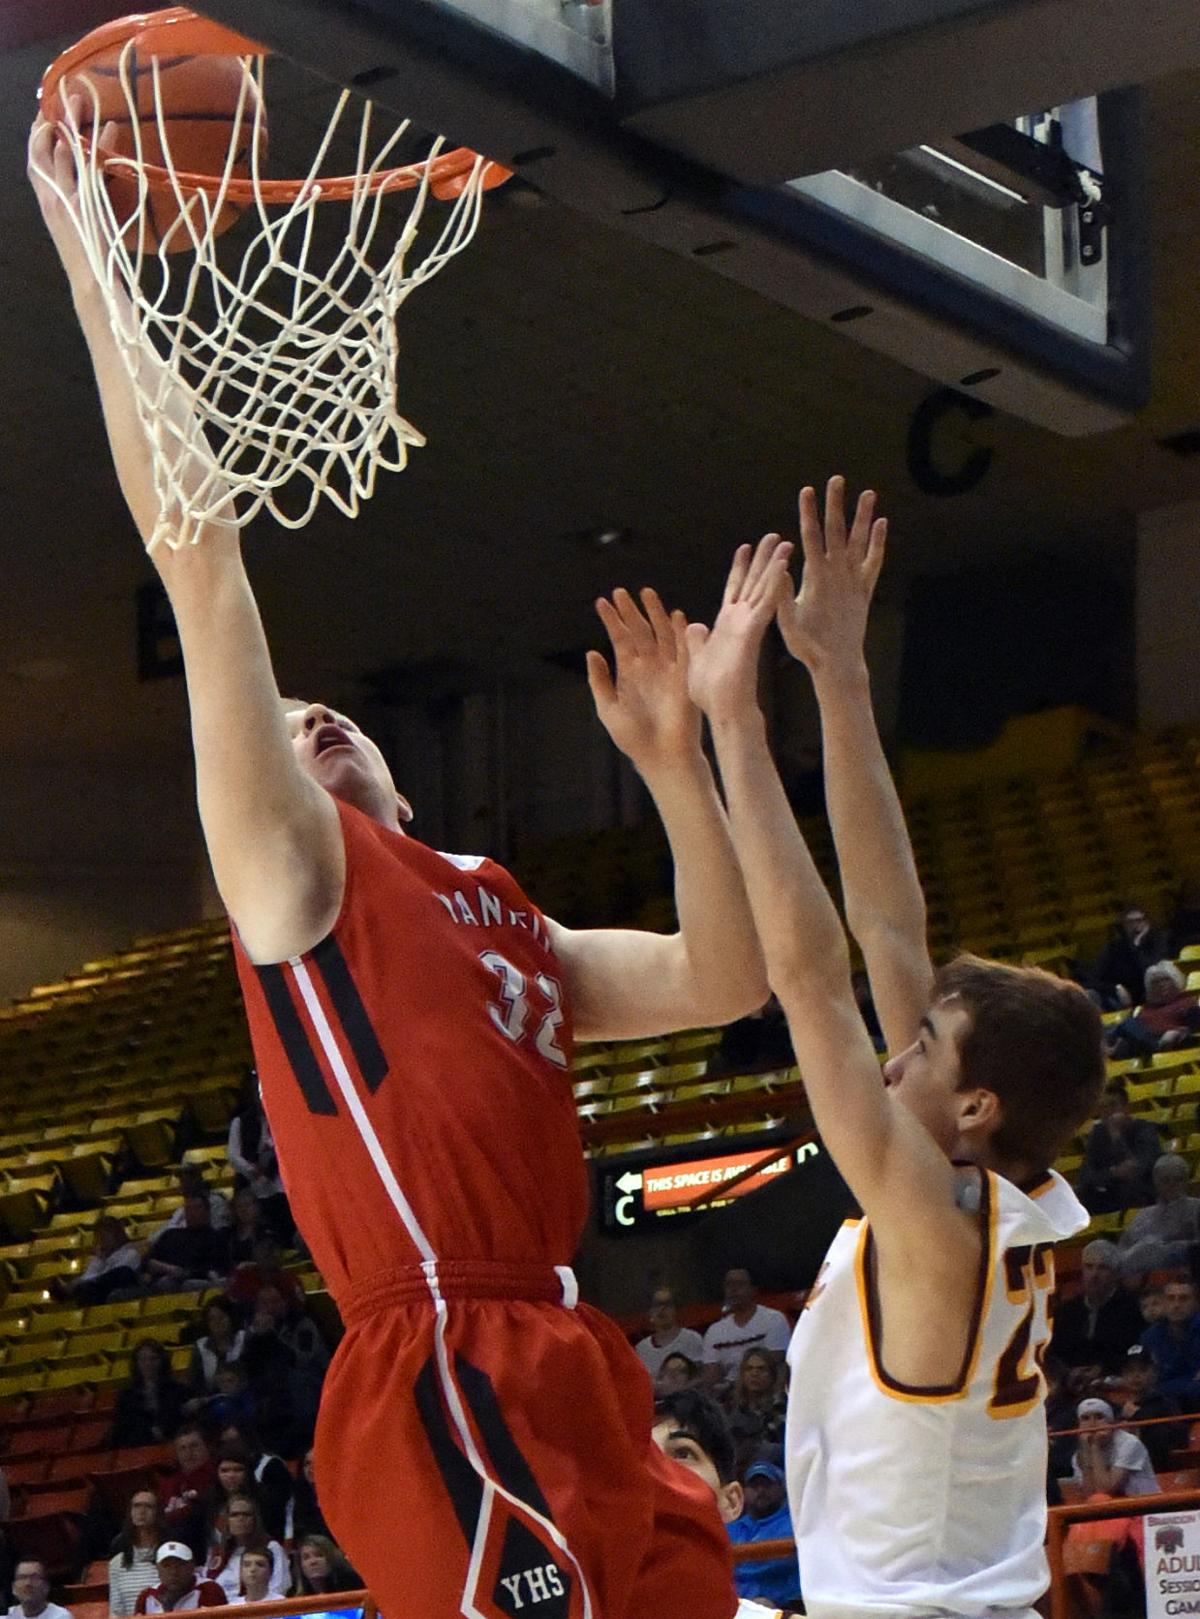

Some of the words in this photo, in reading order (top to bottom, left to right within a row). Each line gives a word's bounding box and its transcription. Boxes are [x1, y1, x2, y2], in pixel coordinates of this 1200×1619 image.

[477, 949, 568, 1071] 32
[646, 1176, 673, 1193] THIS
[673, 1170, 710, 1188] SPACE
[710, 1168, 723, 1182] IS
[615, 1195, 636, 1226] C
[500, 1563, 565, 1609] YHS
